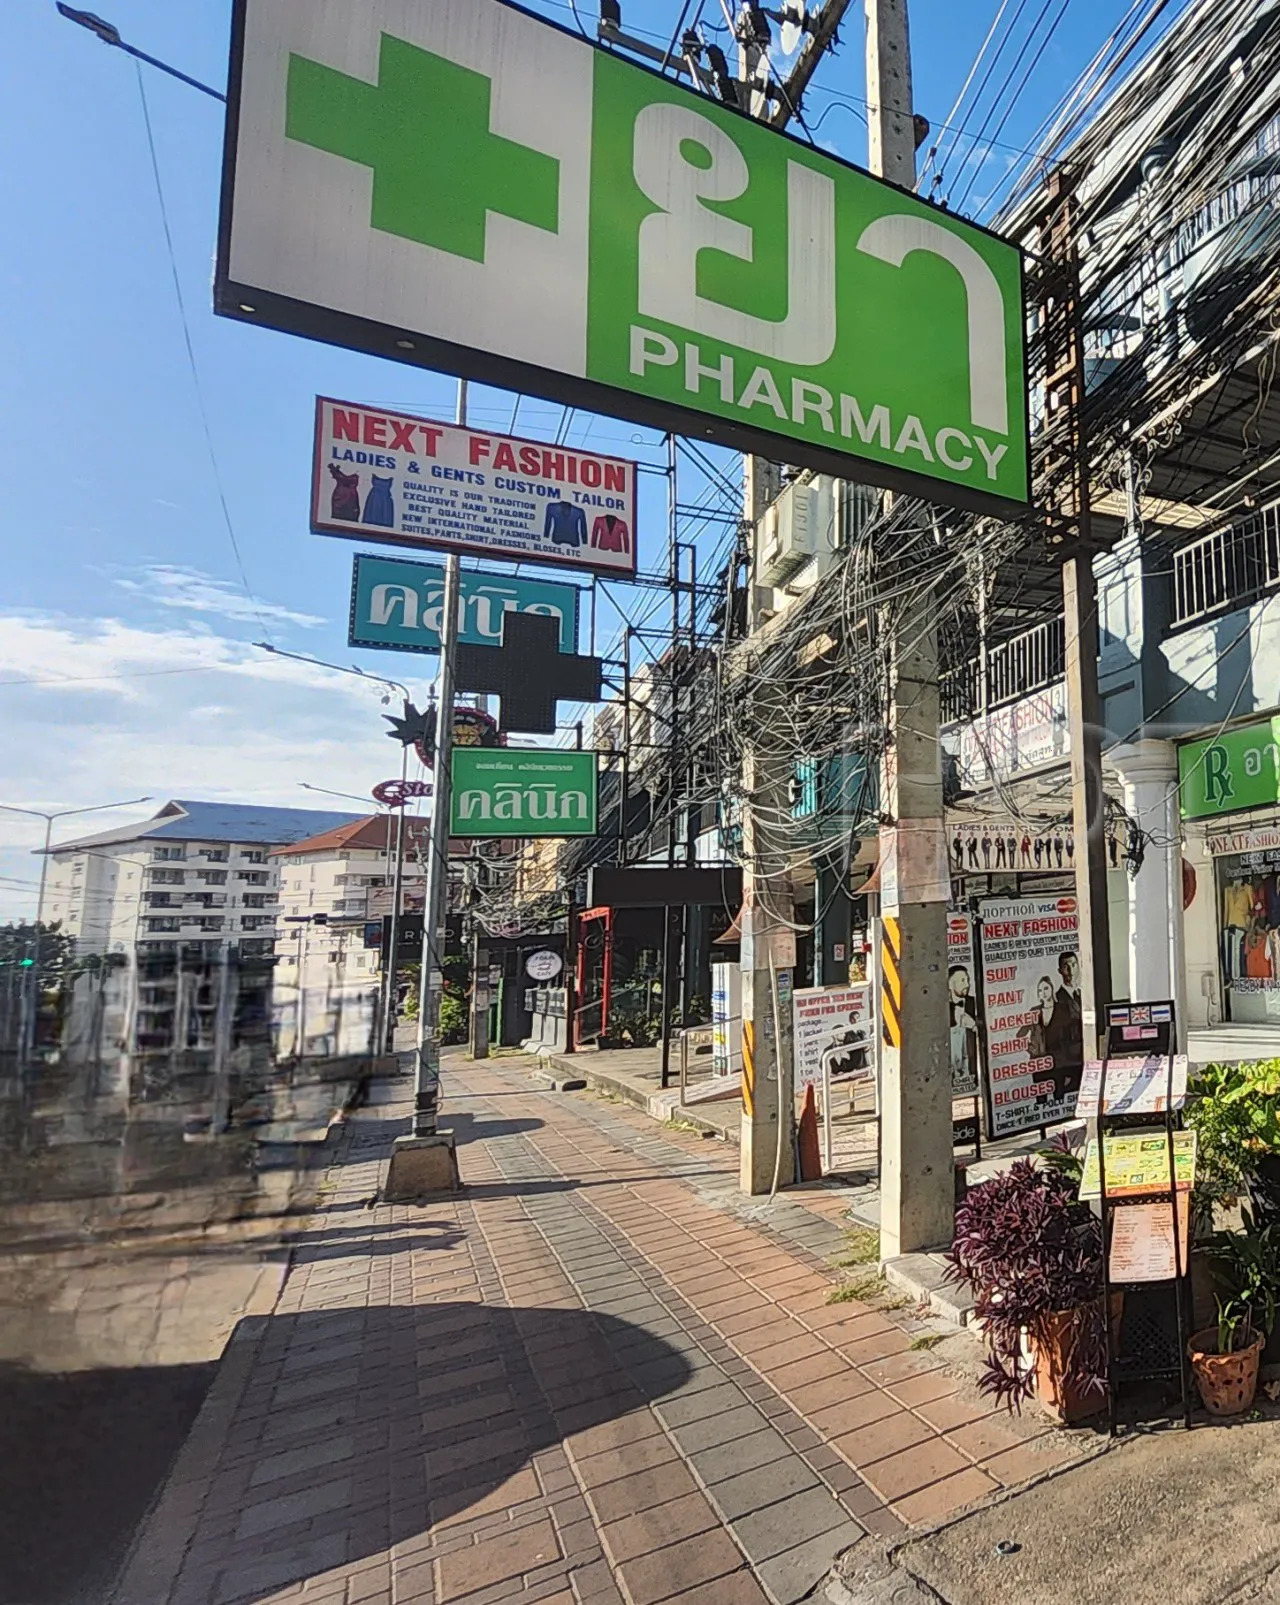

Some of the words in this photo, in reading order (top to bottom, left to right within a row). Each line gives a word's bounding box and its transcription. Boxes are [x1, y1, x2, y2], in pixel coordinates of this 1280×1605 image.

[632, 103, 1008, 436] ยา
[630, 325, 1008, 482] PHARMACY
[332, 408, 443, 458] NEXT
[469, 436, 626, 493] FASHION
[332, 446, 396, 470] LADIES
[408, 459, 420, 475] &
[432, 465, 485, 487] GENTS
[495, 477, 561, 500] CUSTOM
[572, 490, 625, 511] TAILOR
[403, 481, 444, 495] QUALITY
[464, 492, 484, 501] OUR
[488, 496, 536, 511] TRADITION
[403, 492, 456, 508] EXCLUSIVE
[461, 502, 487, 514] HAND
[493, 507, 535, 521] TAILORED
[402, 513, 423, 523] NEW
[428, 517, 496, 535] INTERNATIONAL
[500, 529, 541, 542] FASHIONS
[408, 503, 432, 514] BEST
[438, 508, 478, 522] QUALITY
[483, 516, 529, 530] MATERIAL
[457, 782, 588, 820] คลินิก
[989, 824, 1015, 832] GENTS
[1038, 904, 1056, 913] VISA
[984, 921, 1020, 940] NEXT
[1022, 915, 1078, 937] FASHION
[984, 951, 1018, 964] QUALITY
[986, 966, 1017, 983] SUIT
[987, 989, 1024, 1008] PANT
[990, 1010, 1041, 1033] JACKET
[991, 1037, 1030, 1057] SHIRT
[992, 1057, 1054, 1082] DRESSES
[993, 1080, 1055, 1107] BLOUSES
[995, 1107, 1031, 1121] T-SHIRT
[1042, 1098, 1064, 1110] POLO
